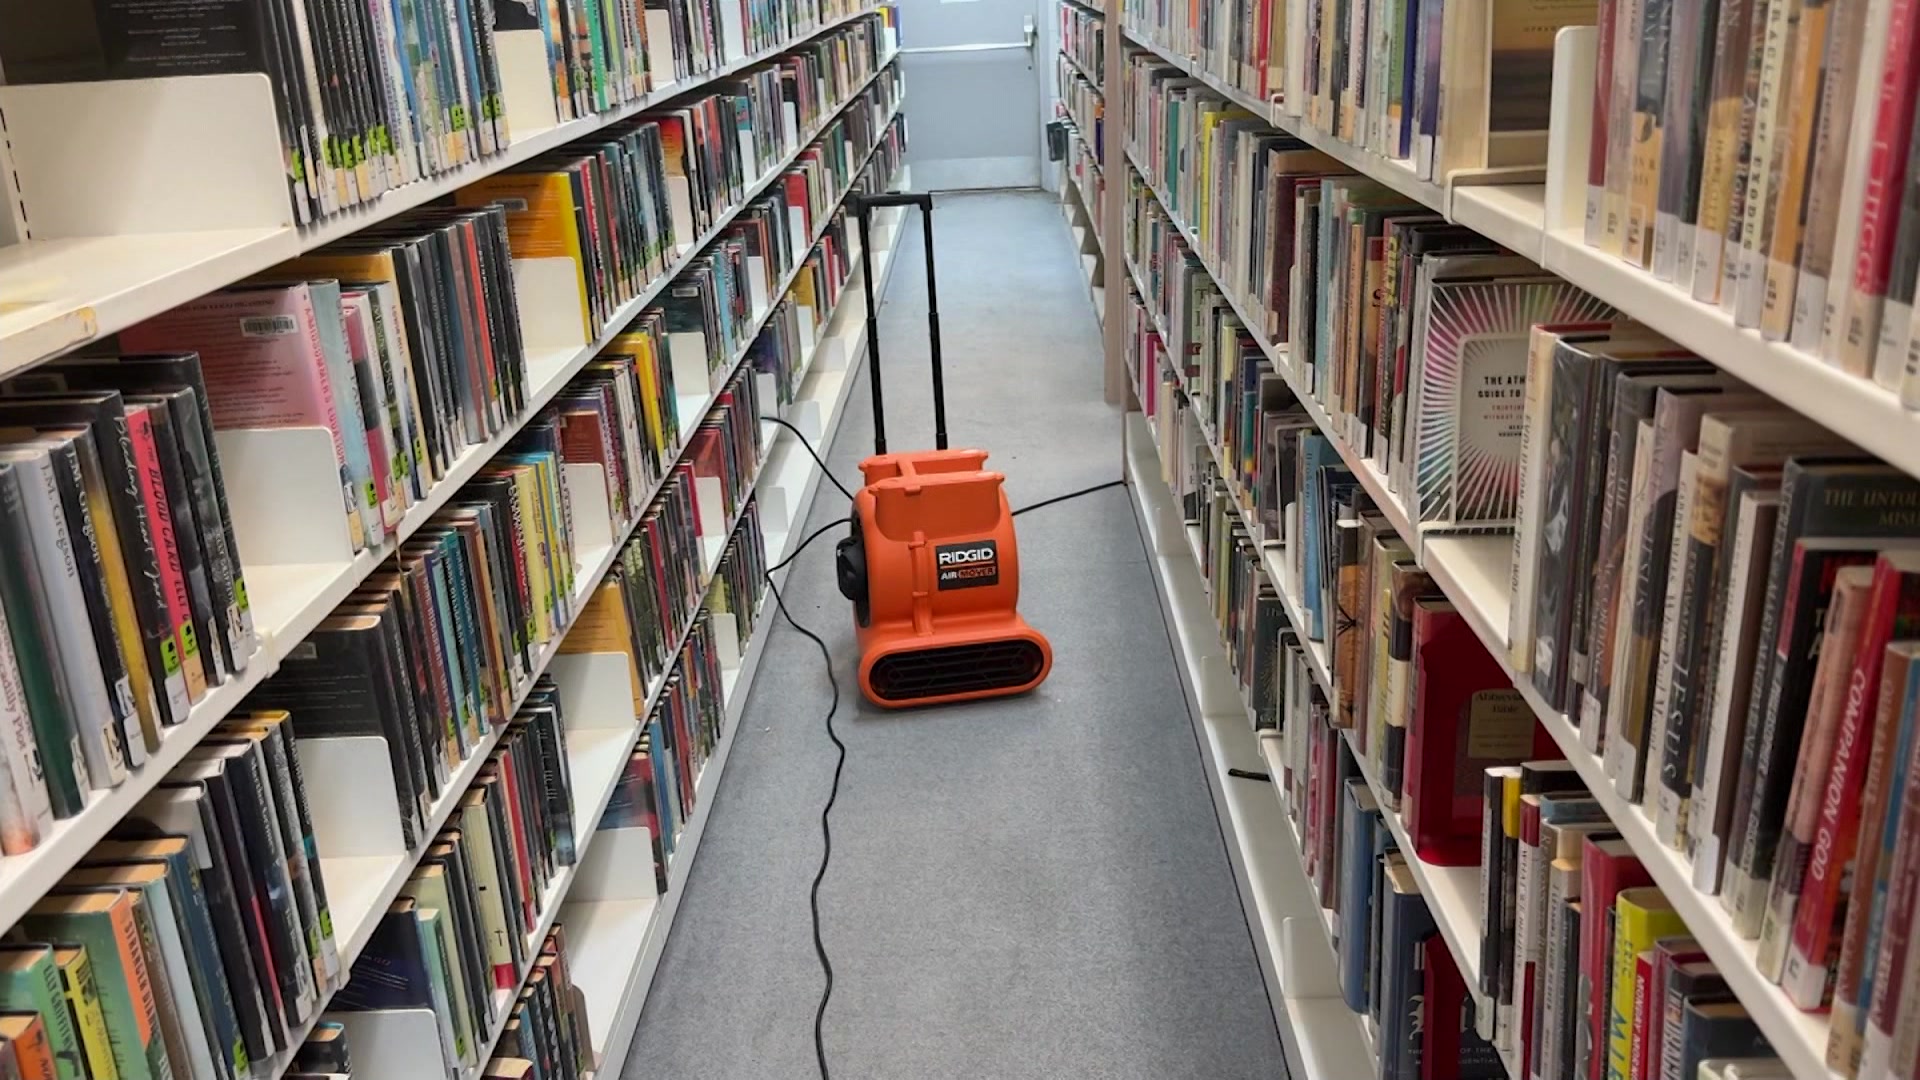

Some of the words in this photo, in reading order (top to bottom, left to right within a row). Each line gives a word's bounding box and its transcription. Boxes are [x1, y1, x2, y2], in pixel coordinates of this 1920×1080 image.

[1478, 390, 1504, 398] GUIDE
[1510, 389, 1520, 398] TO
[1484, 376, 1502, 385] THE
[40, 463, 57, 500] J.M.
[50, 504, 77, 578] Gregson
[66, 450, 83, 487] J.M.
[75, 490, 101, 564] Gregson
[148, 466, 169, 523] BLOOD
[162, 526, 180, 573] CARD
[173, 578, 187, 607] ELLY
[938, 547, 994, 564] RIDGID
[941, 571, 957, 580] AIR
[959, 566, 996, 578] MOVER
[1634, 533, 1653, 608] JESUS
[1591, 559, 1613, 674] ACCORDING
[1676, 550, 1697, 655] EXCAVATING
[1661, 662, 1688, 779] JESUS
[1821, 668, 1868, 824] COMPANION
[1809, 826, 1833, 881] GOD
[42, 964, 58, 991] ELLY
[122, 921, 149, 991] STRANGER
[1621, 939, 1634, 978] ERIC
[1631, 975, 1644, 1033] MONDAY
